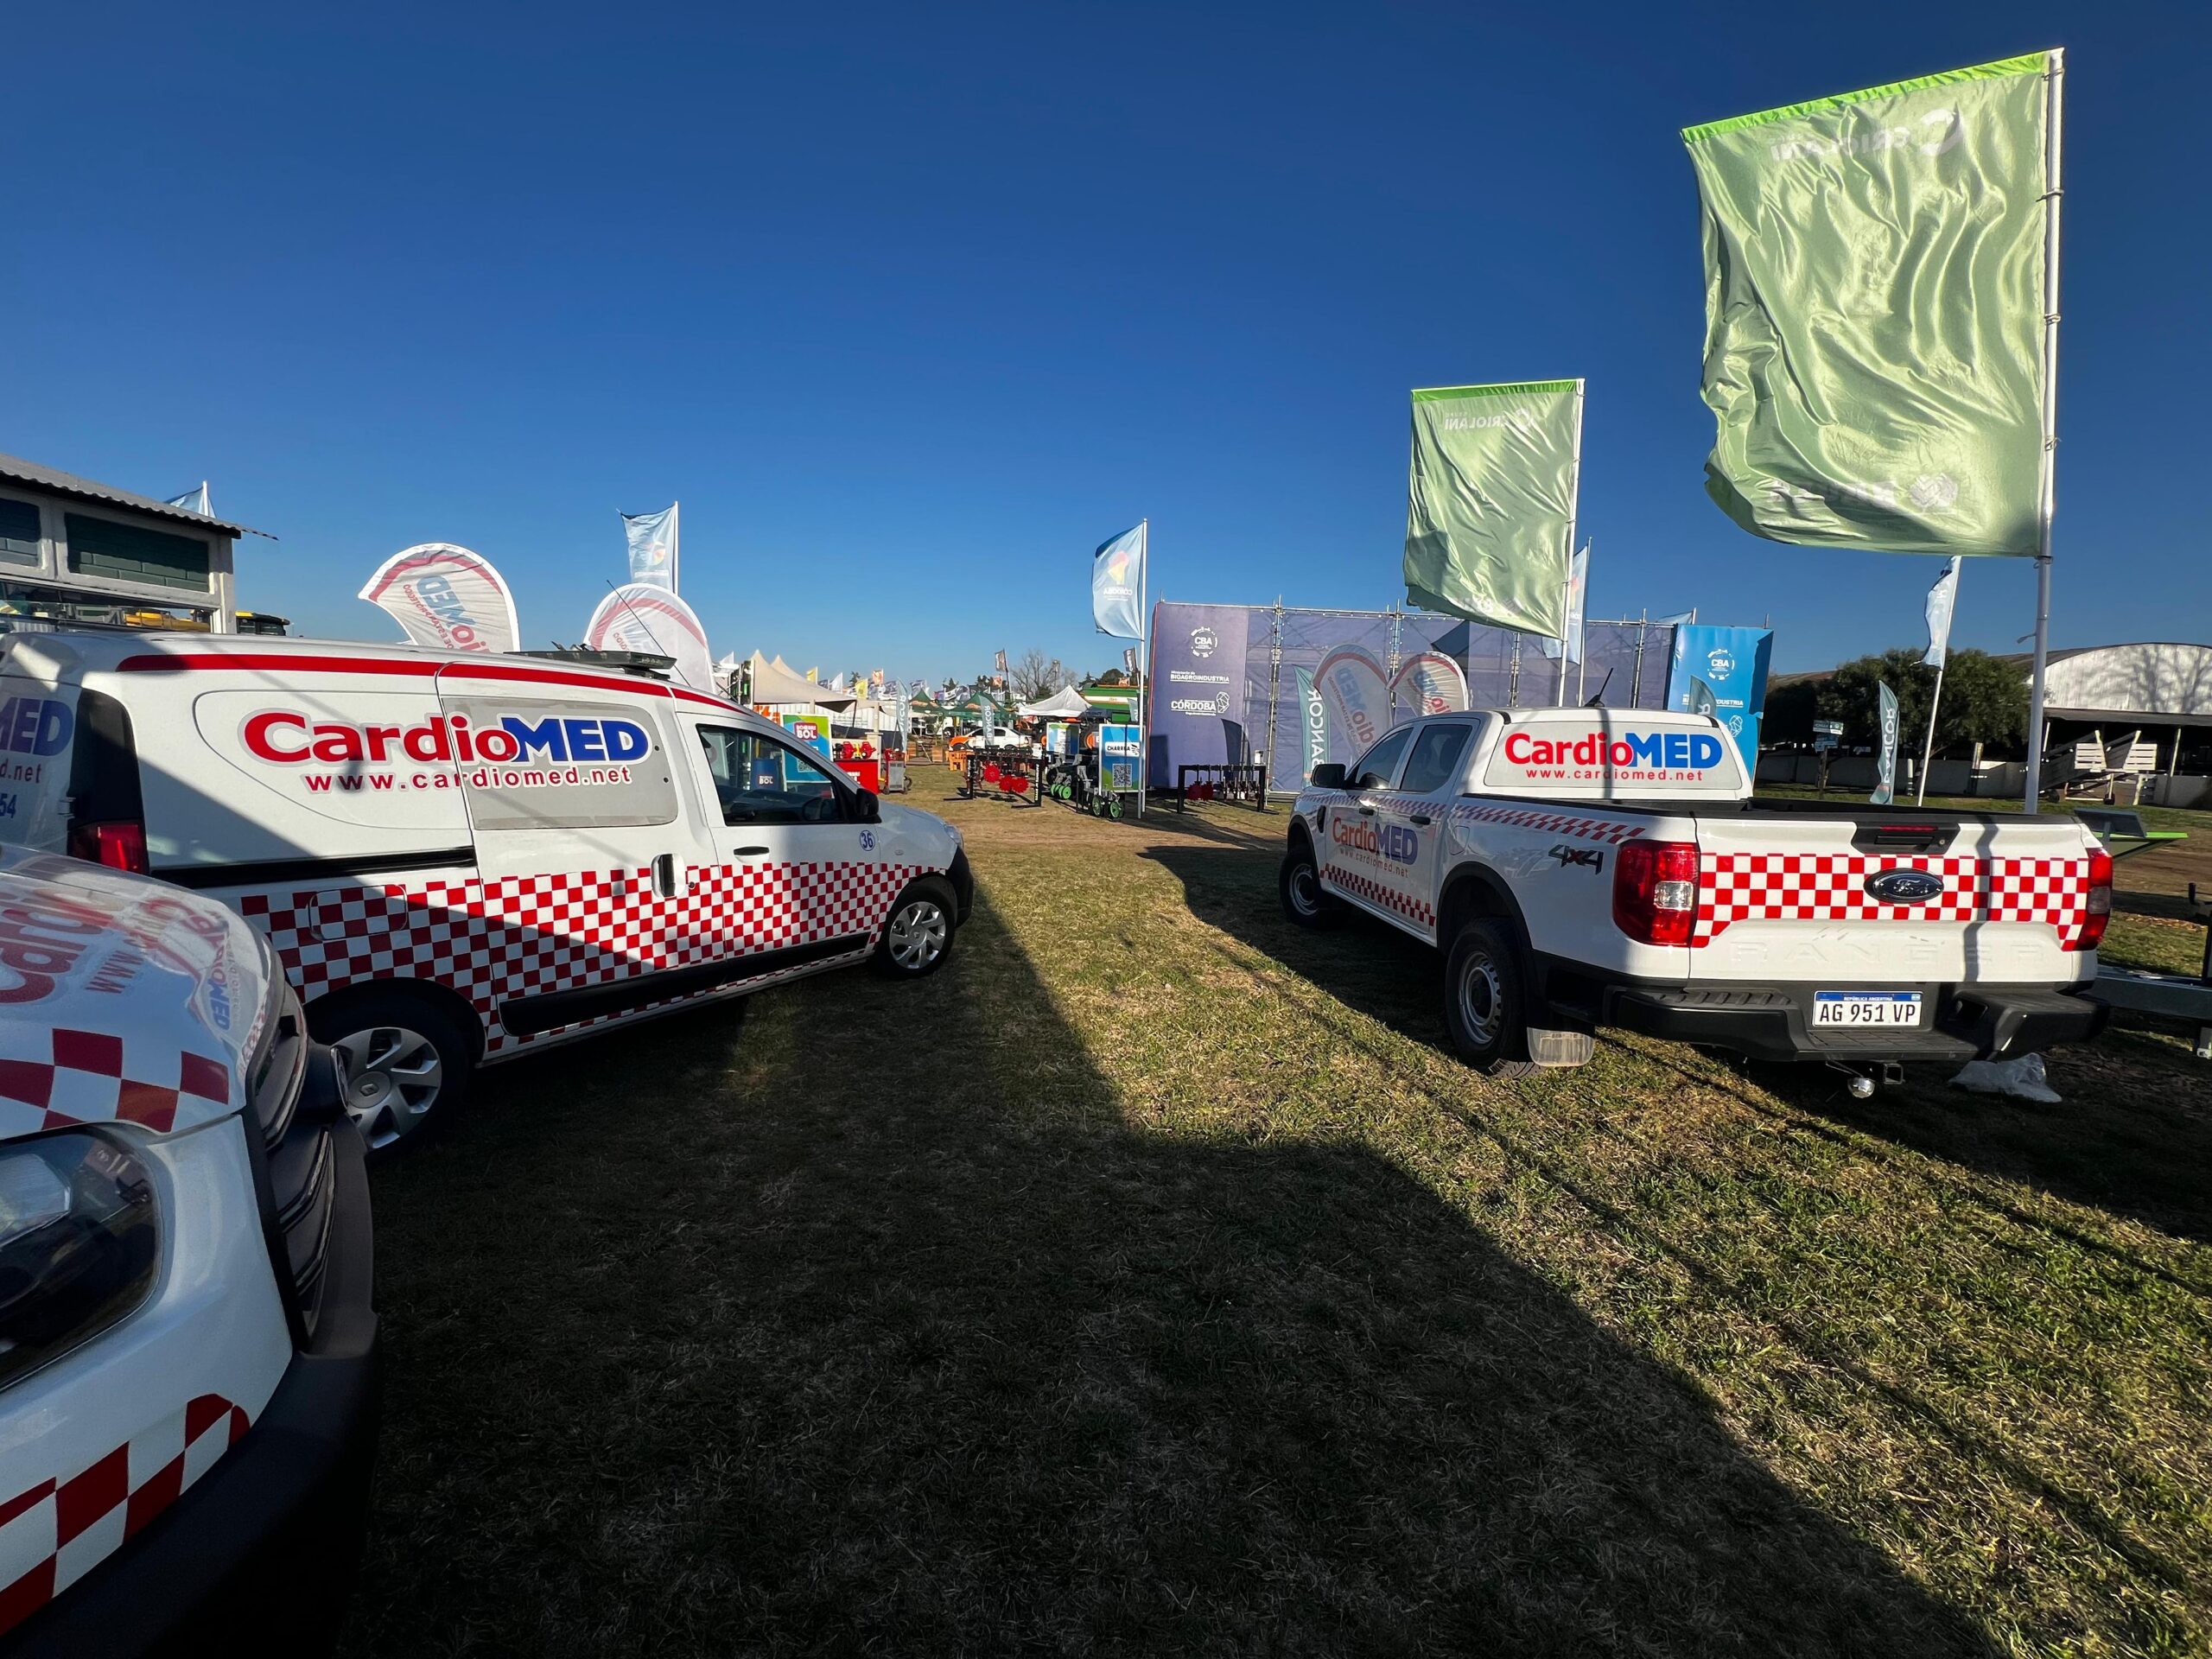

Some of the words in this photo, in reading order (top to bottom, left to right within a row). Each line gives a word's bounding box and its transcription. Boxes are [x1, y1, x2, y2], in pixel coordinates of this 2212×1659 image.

[1171, 699, 1217, 711] CÓRDOBA
[245, 712, 649, 762] CardioMED
[797, 729, 817, 740] BOL
[1504, 732, 1723, 770] CardioMED
[305, 766, 632, 792] www.cardiomed.net
[1525, 767, 1703, 782] www.cardiomed.net
[861, 832, 874, 849] 36
[1332, 816, 1419, 865] CardioMED
[1339, 848, 1408, 878] www.cardiomed.net
[1548, 843, 1605, 876] 4x4
[1730, 940, 2048, 964] RANGER
[1819, 1003, 1843, 1022] AG
[1850, 1003, 1885, 1022] 951
[1893, 1003, 1916, 1022] VP
